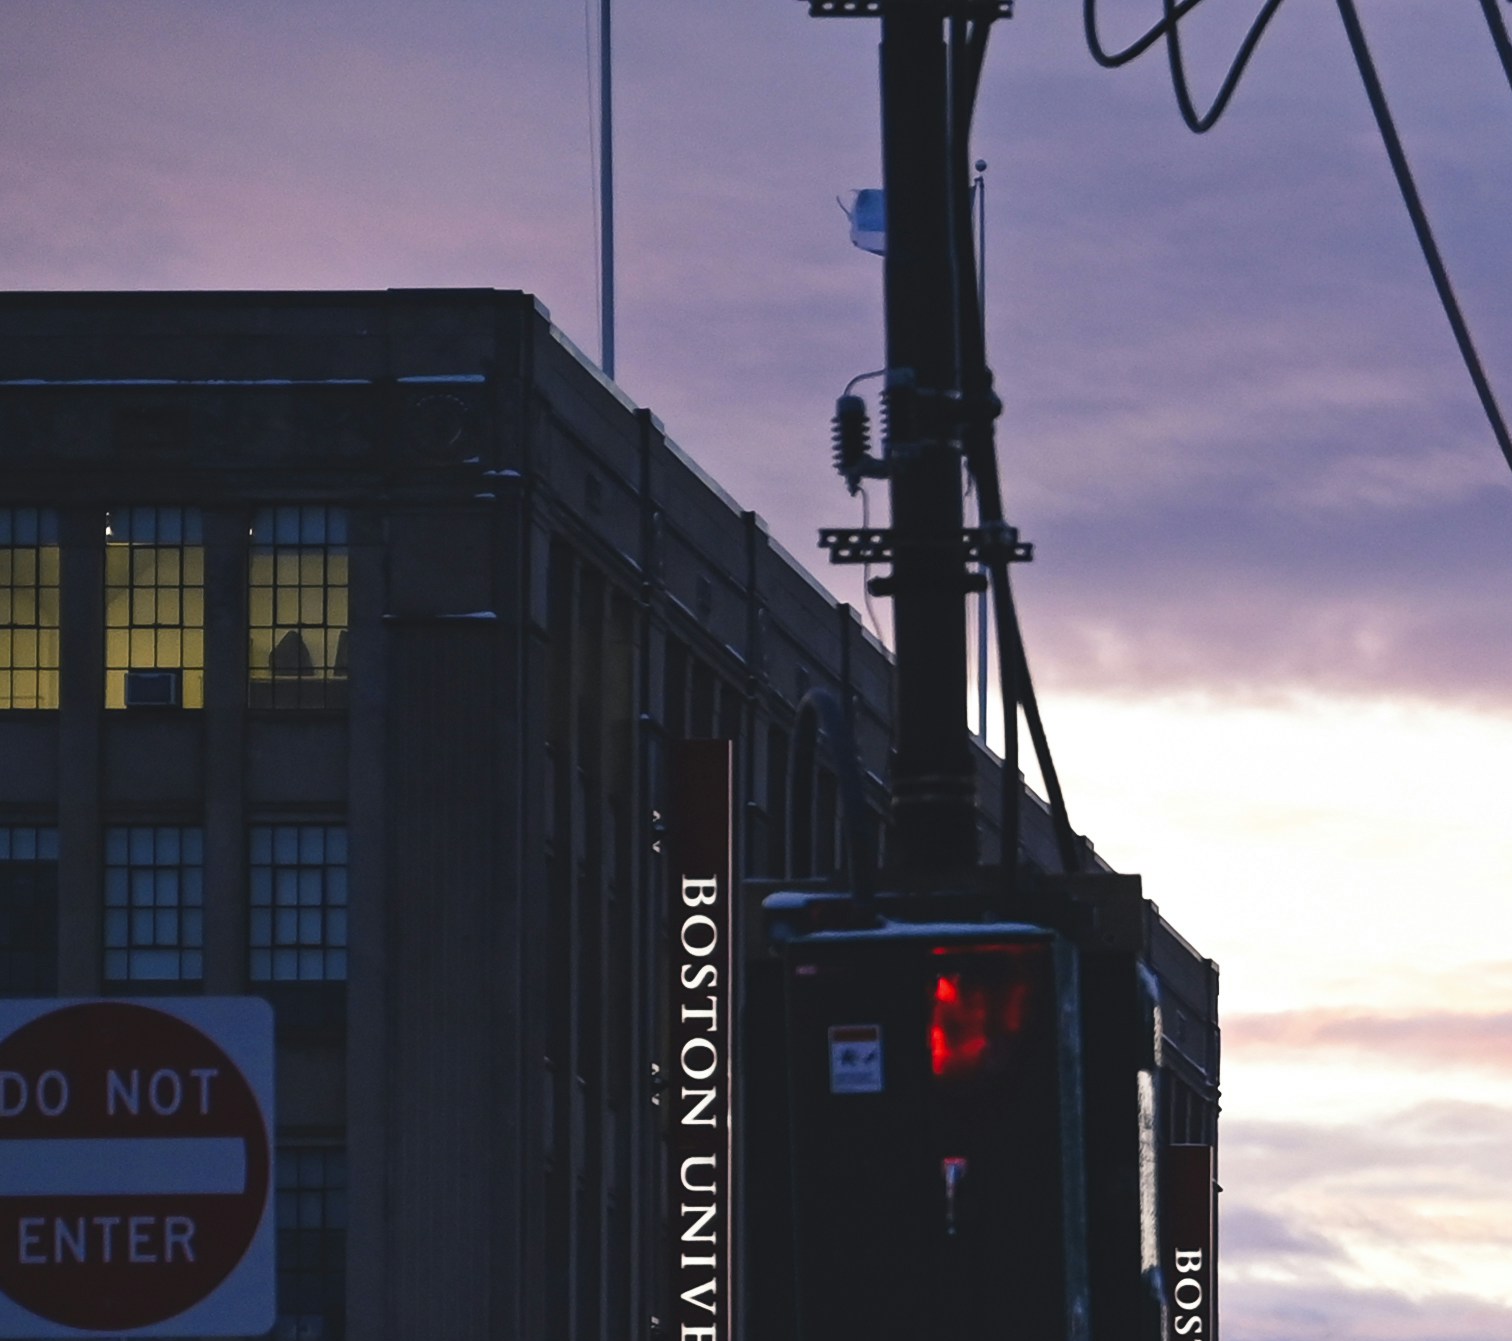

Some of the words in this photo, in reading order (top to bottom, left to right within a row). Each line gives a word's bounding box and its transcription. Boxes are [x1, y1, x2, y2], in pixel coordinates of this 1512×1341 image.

[681, 873, 718, 1128] BOSTON
[0, 1069, 70, 1118] DO
[106, 1069, 218, 1117] NOT
[18, 1215, 197, 1265] ENTER
